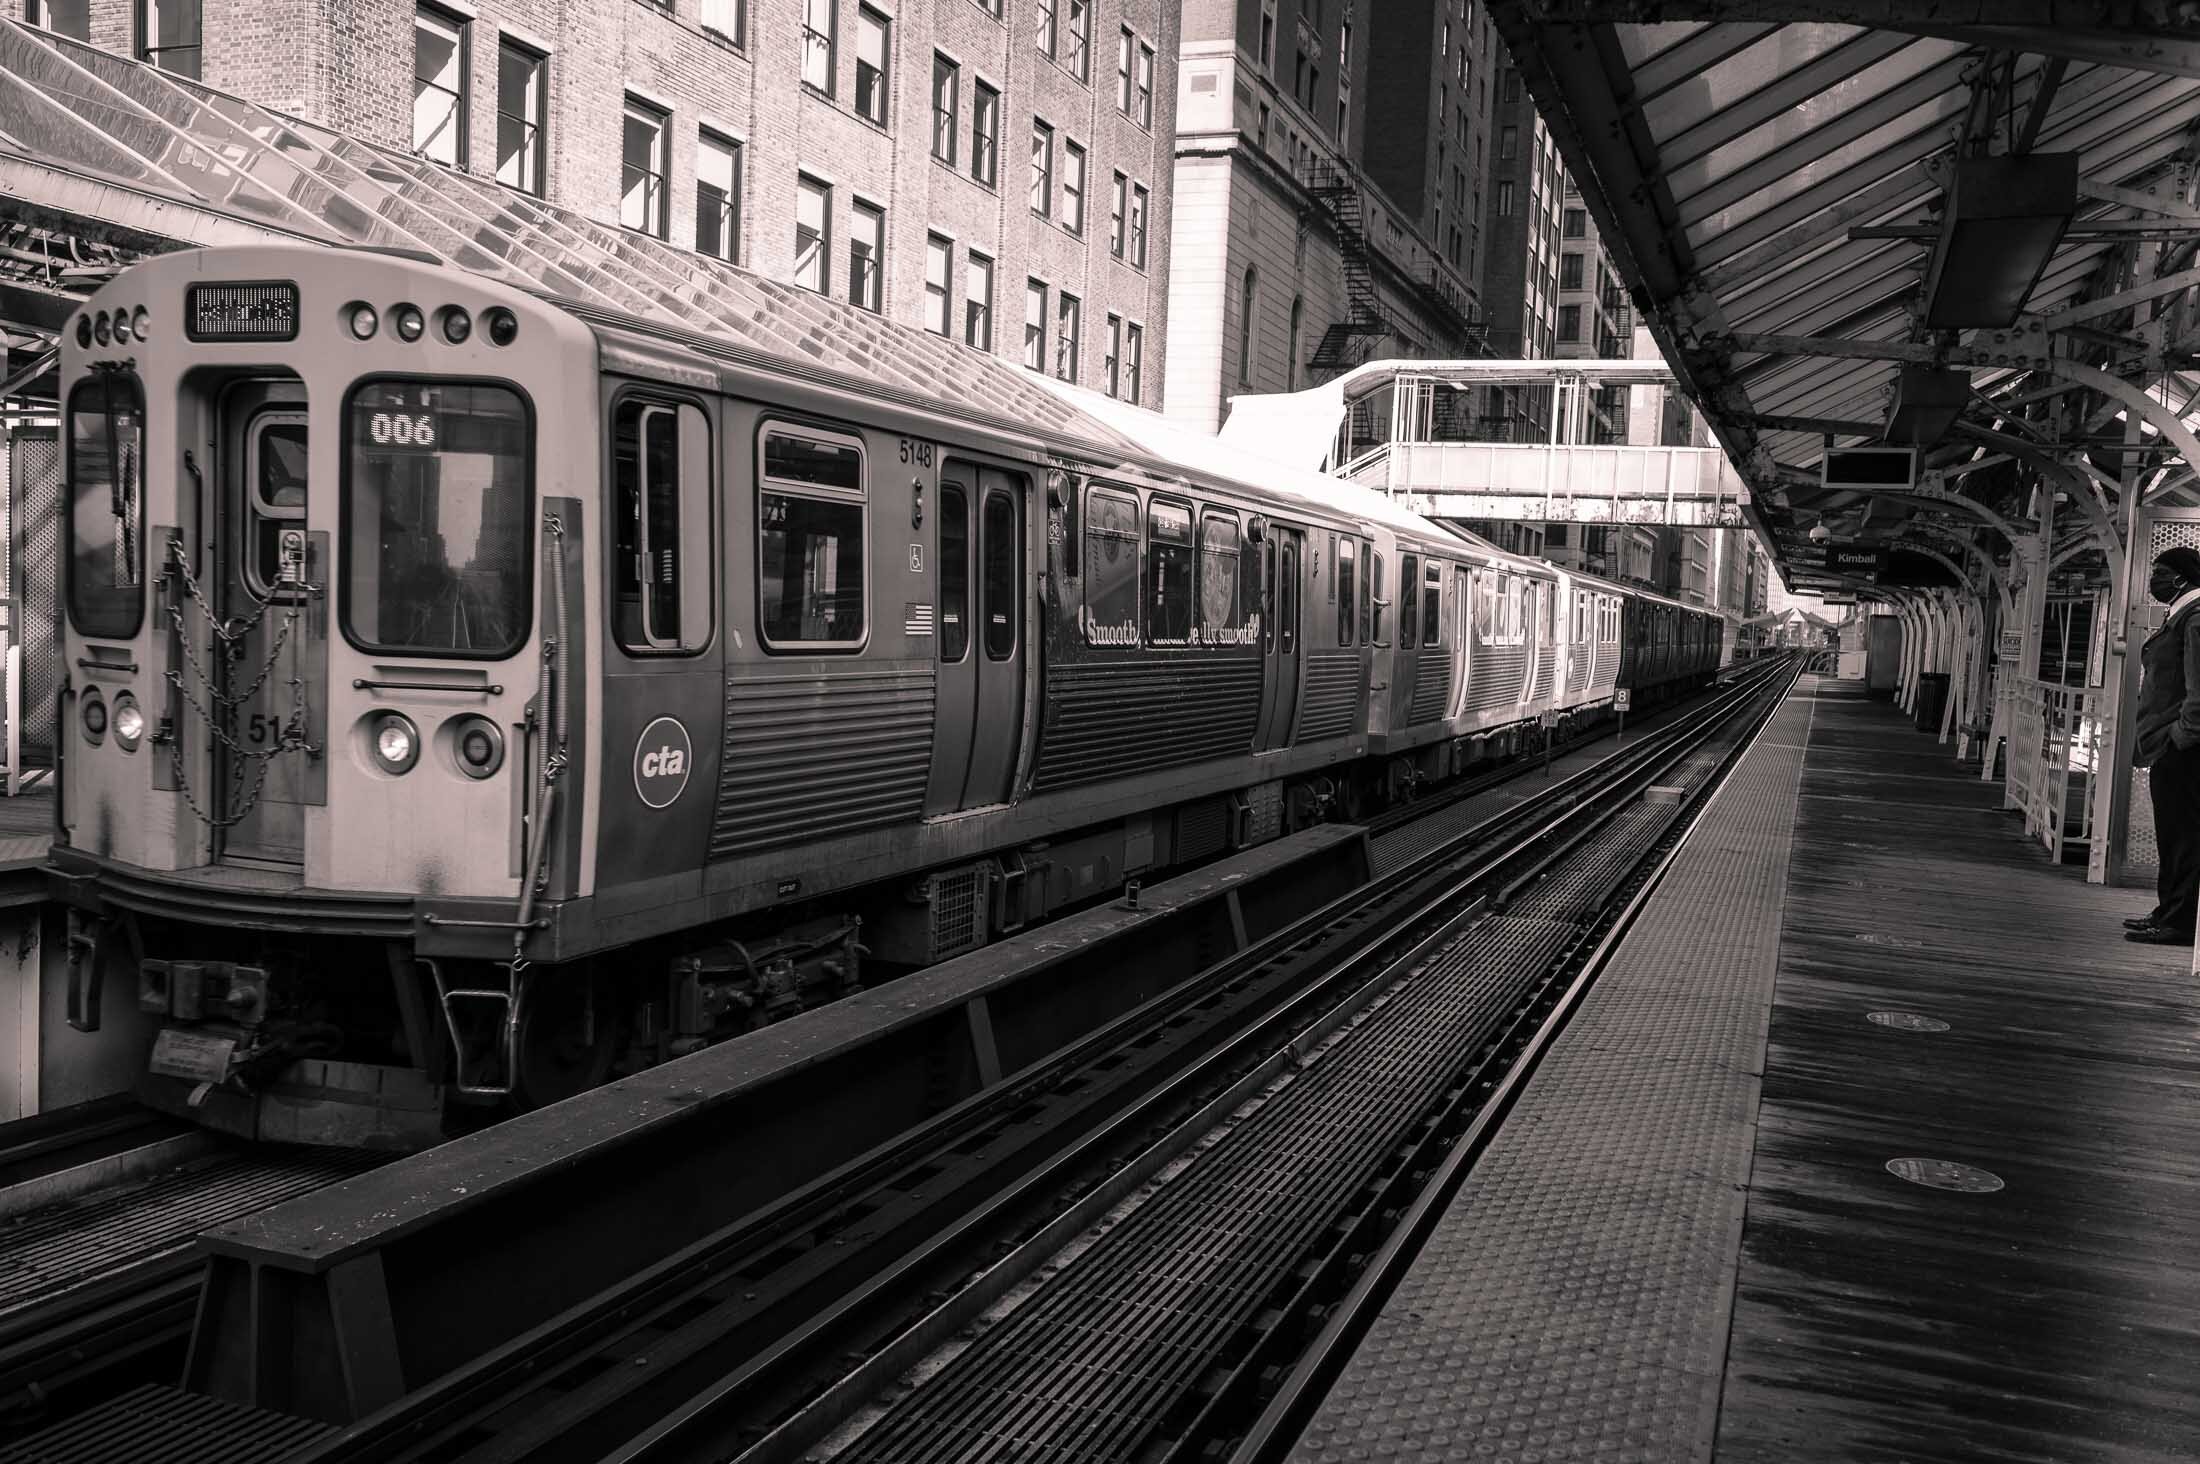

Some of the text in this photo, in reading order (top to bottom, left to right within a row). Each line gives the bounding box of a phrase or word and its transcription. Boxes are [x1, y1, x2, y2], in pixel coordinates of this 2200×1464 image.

[371, 413, 435, 444] 006
[900, 440, 931, 468] 5148
[1838, 553, 1876, 563] Kimball
[1618, 690, 1627, 702] 8
[642, 745, 685, 778] cta
